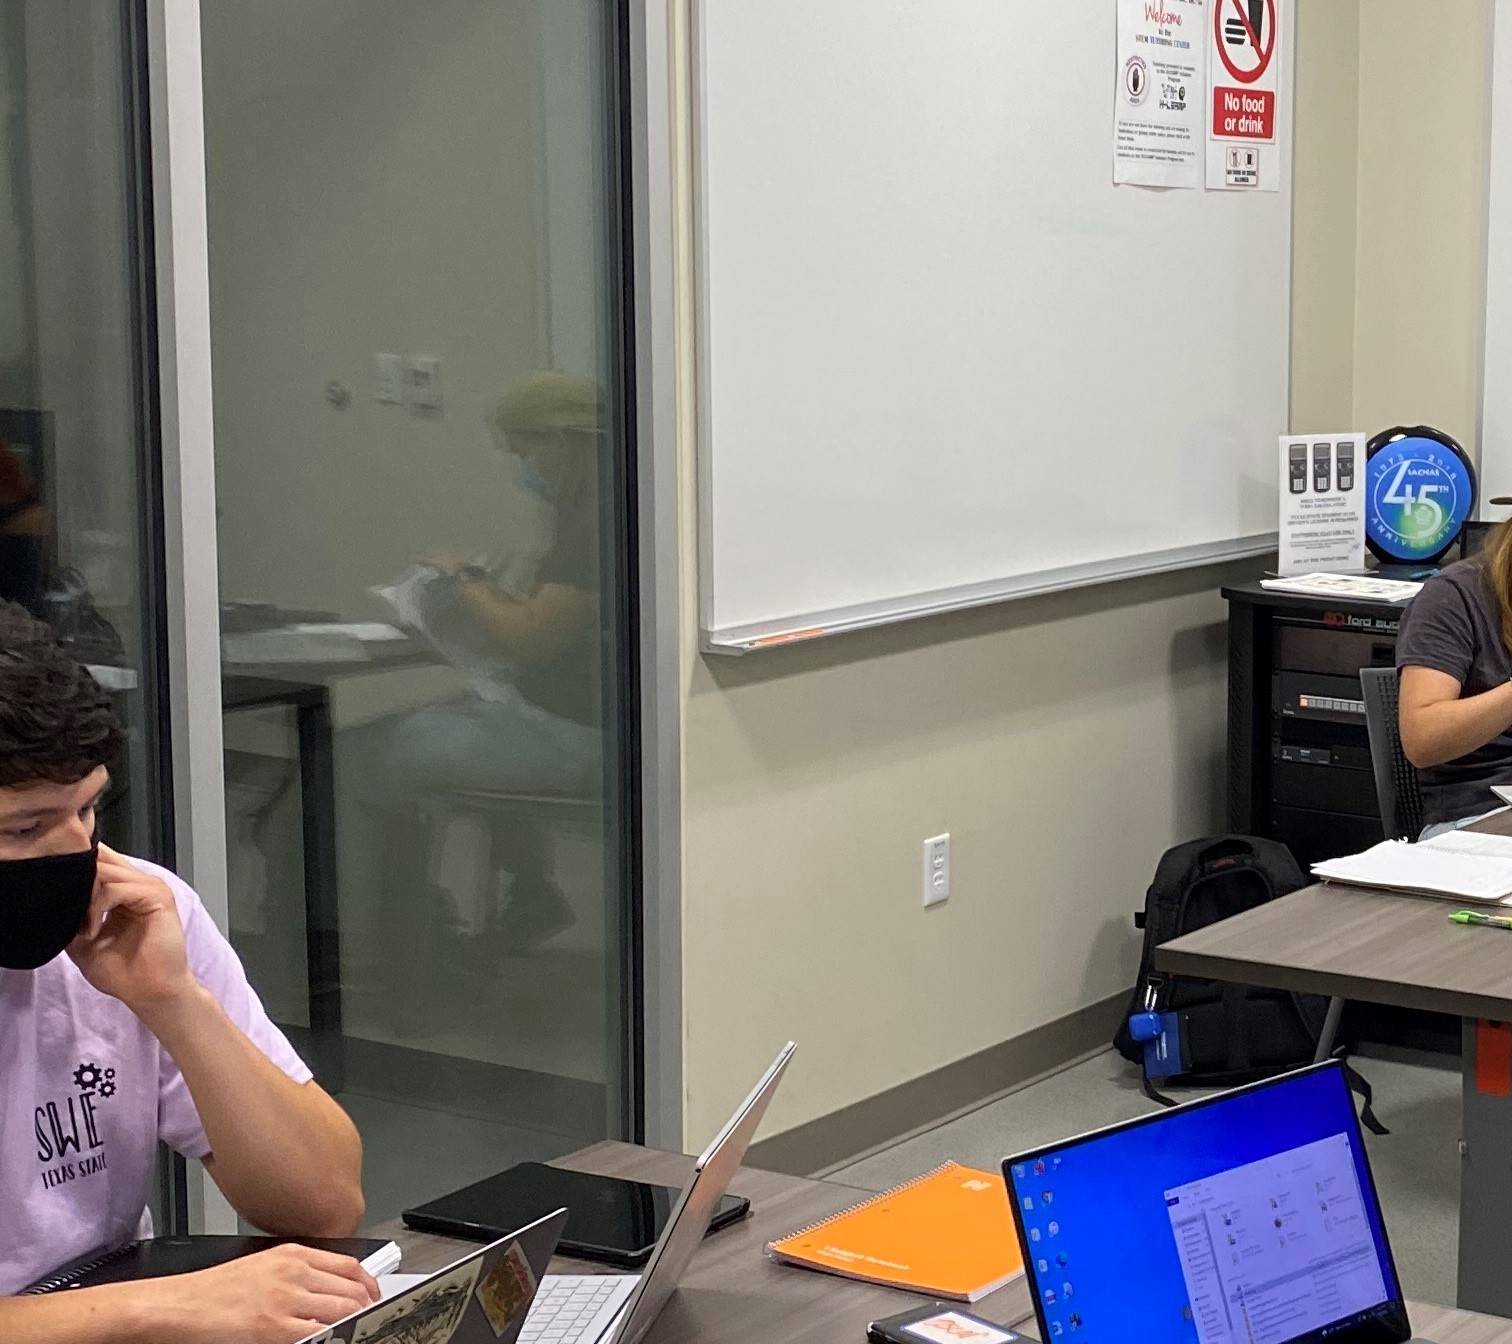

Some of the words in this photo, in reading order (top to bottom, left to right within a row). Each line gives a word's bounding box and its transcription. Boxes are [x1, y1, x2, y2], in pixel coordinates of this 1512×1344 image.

[1224, 92, 1240, 111] No
[1242, 94, 1265, 113] food
[1224, 117, 1237, 131] or
[1238, 115, 1264, 134] drink
[34, 1091, 104, 1162] SWE
[42, 1164, 75, 1190] TEXAS
[79, 1152, 107, 1177] STATE
